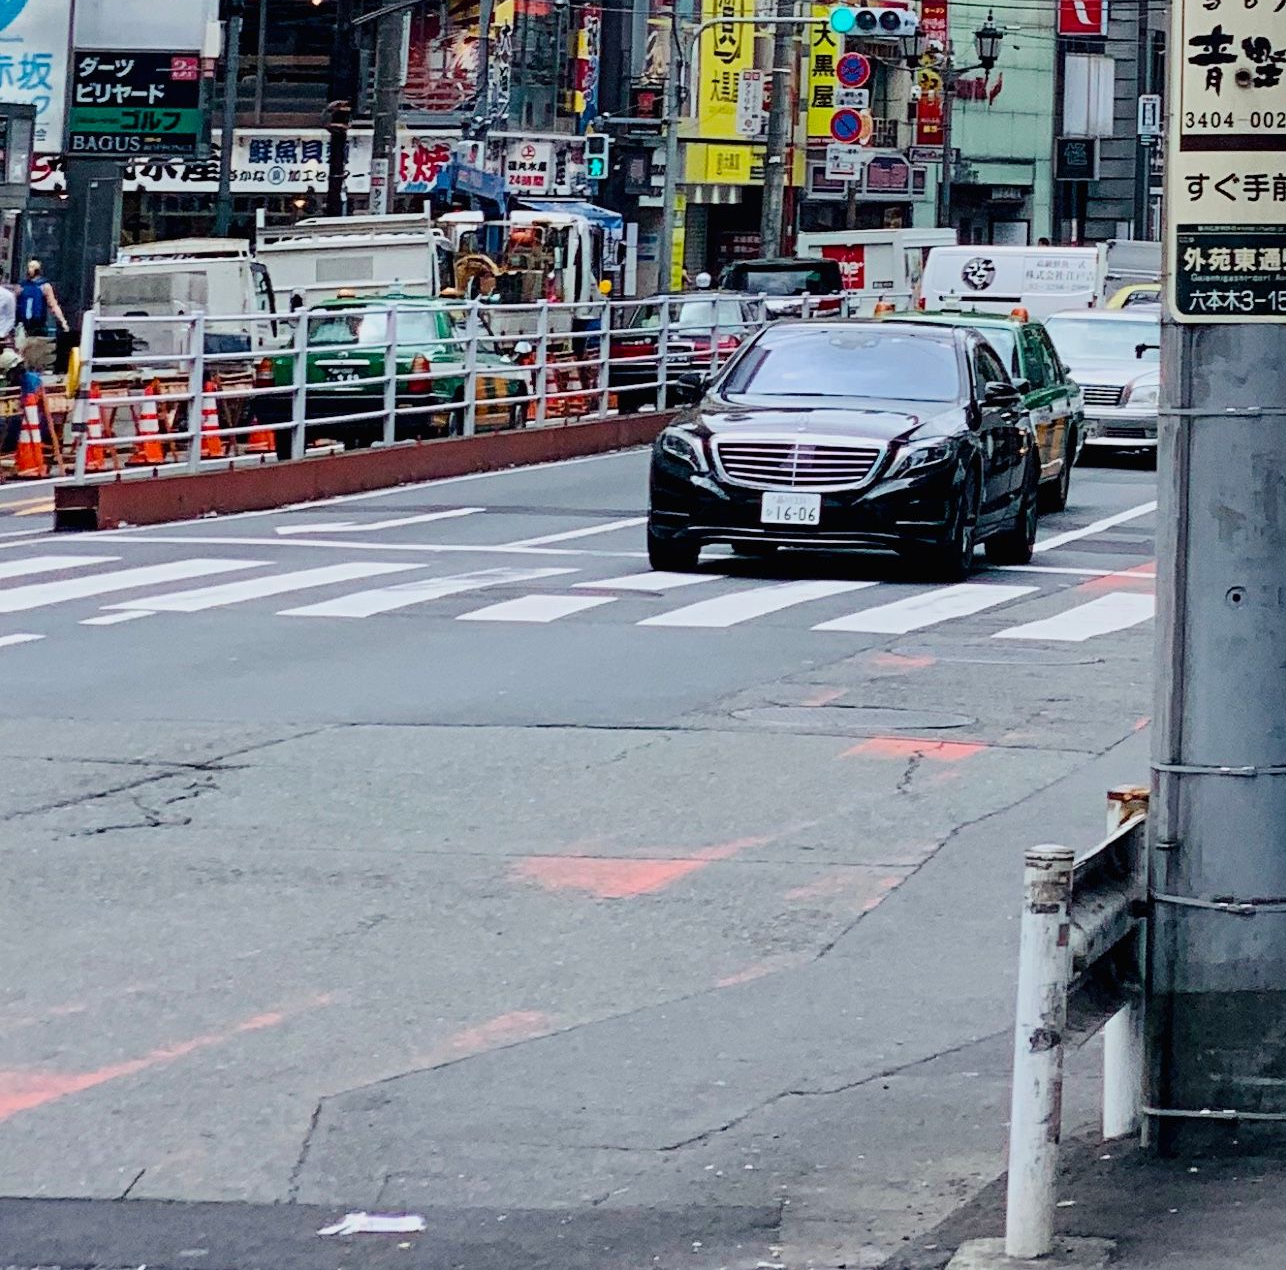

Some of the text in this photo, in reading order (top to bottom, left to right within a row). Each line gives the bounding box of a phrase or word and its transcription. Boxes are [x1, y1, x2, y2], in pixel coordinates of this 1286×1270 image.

[79, 56, 136, 78] ダーツ
[811, 20, 837, 108] 大黒屋
[75, 82, 165, 104] ビリヤード
[72, 135, 141, 151] BAGUS
[775, 506, 816, 522] 16-06
